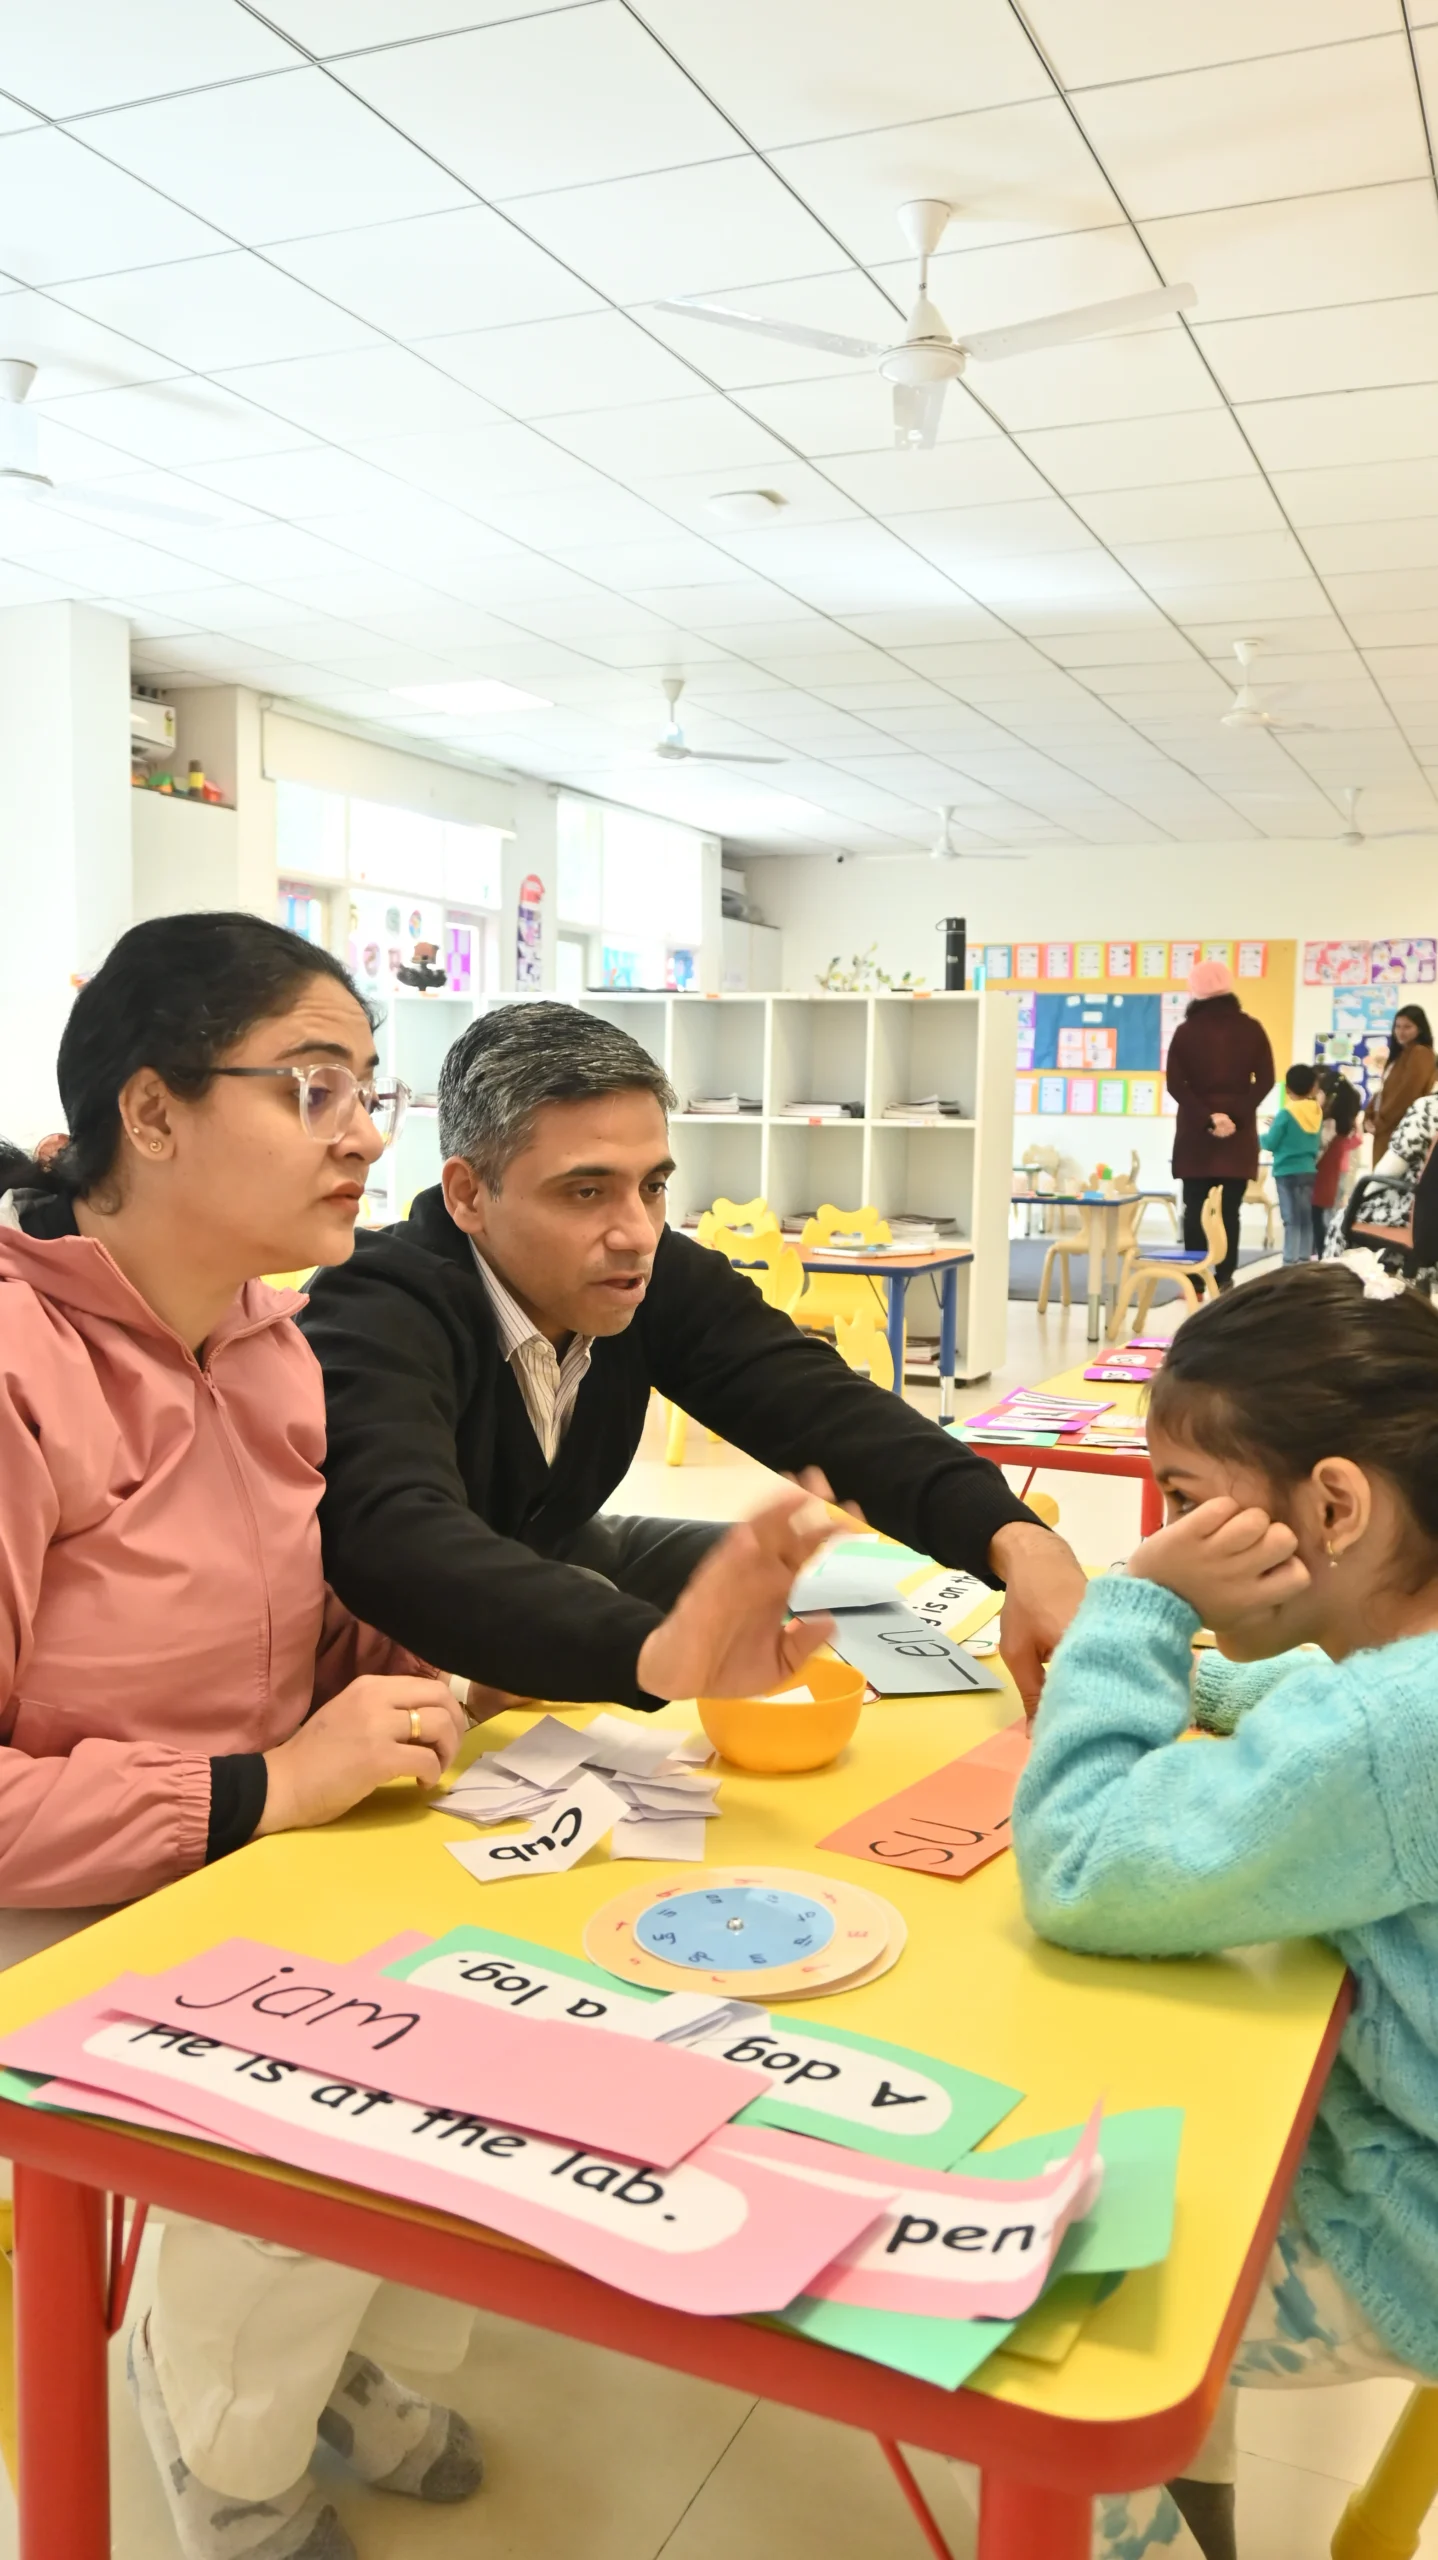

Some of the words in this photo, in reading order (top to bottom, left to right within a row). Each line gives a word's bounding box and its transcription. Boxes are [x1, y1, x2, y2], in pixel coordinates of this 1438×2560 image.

[912, 1601, 949, 1614] is
[938, 1586, 969, 1600] on
[652, 1930, 677, 1945] ug
[458, 1958, 549, 2006] log.
[174, 1966, 421, 2051] jam
[566, 1997, 608, 2018] a
[722, 2036, 841, 2085] dog
[310, 2084, 395, 2116] at
[871, 2081, 928, 2108] A
